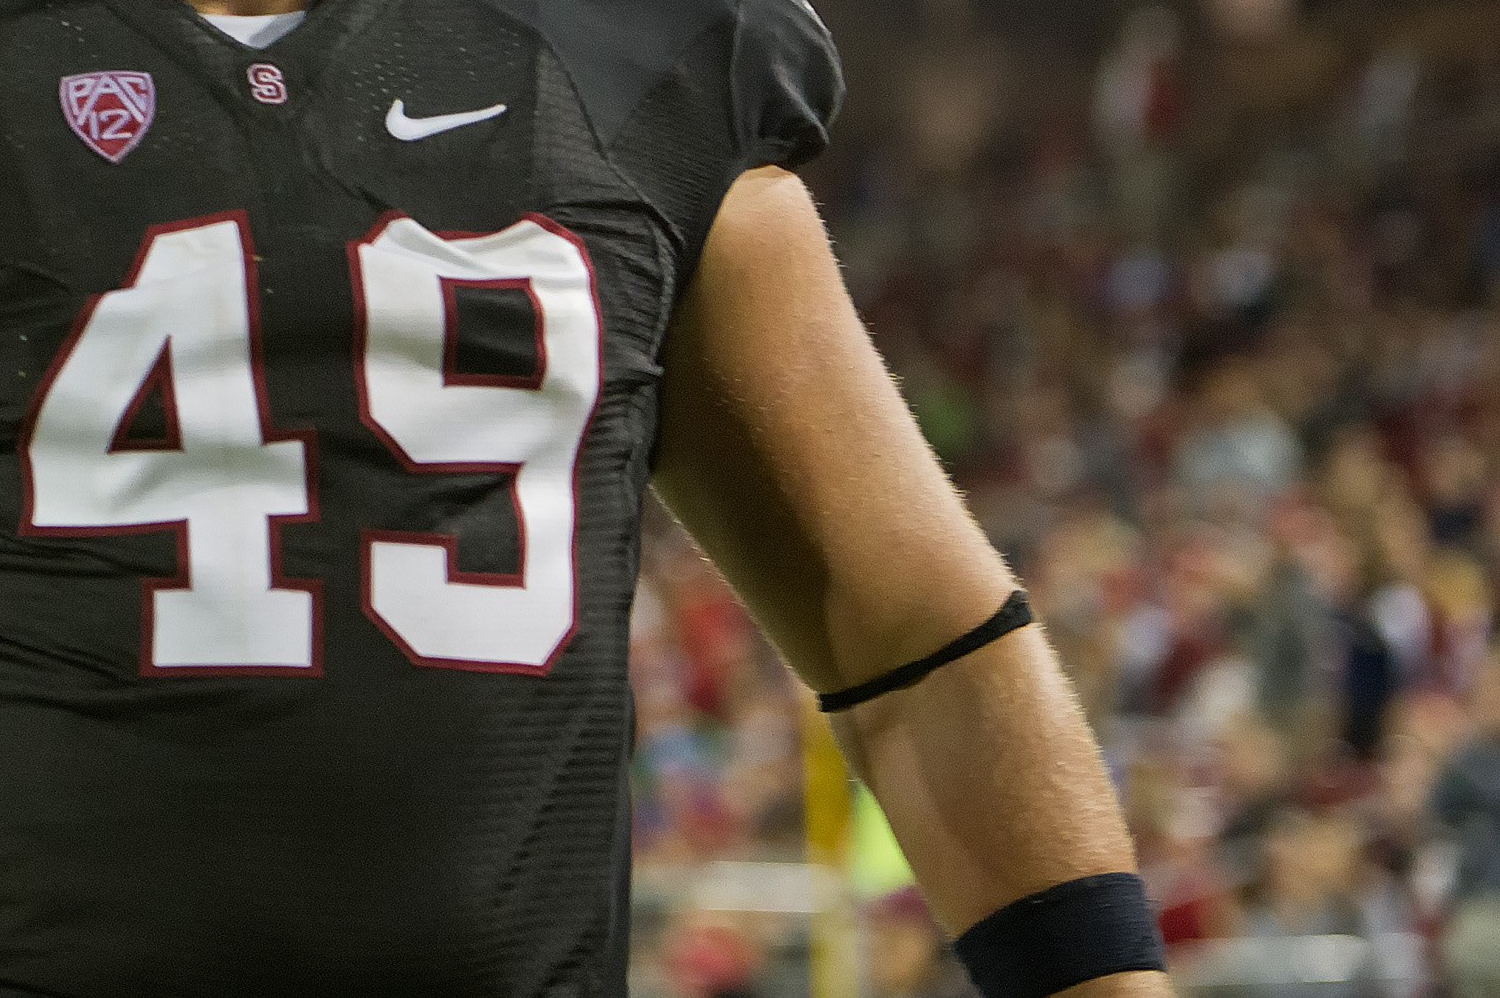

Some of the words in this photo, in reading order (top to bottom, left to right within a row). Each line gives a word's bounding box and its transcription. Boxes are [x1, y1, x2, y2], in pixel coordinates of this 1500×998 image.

[69, 75, 148, 125] PAC
[246, 62, 288, 104] S
[90, 108, 133, 140] 12
[18, 209, 602, 677] 49
